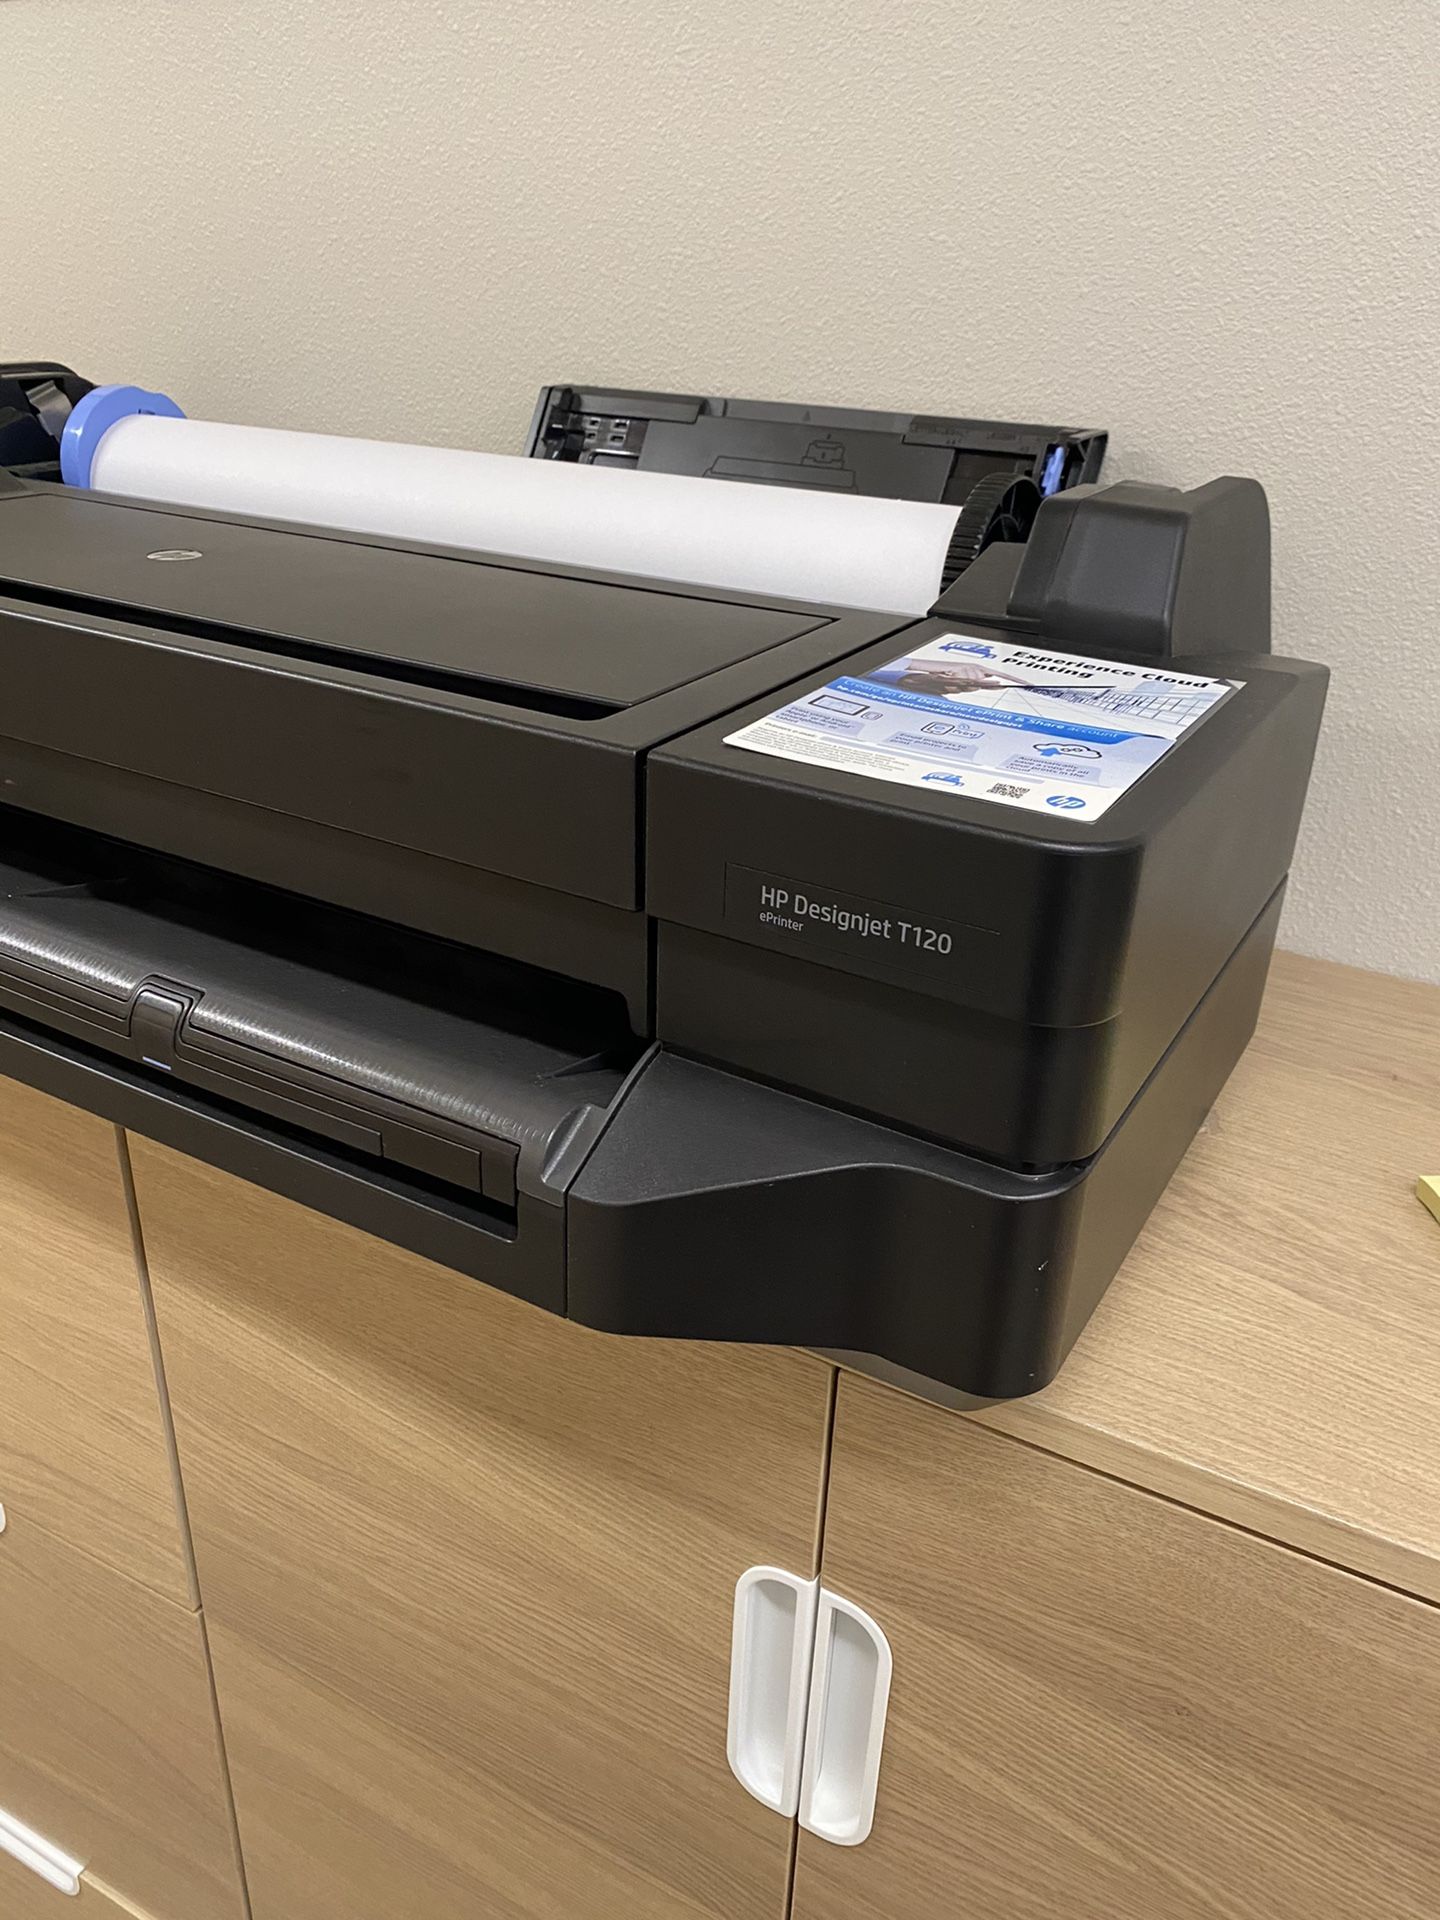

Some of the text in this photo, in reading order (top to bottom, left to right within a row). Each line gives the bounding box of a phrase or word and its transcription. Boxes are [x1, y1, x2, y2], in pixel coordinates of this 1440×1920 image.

[1002, 657, 1095, 679] Printing
[1013, 651, 1209, 688] Experience Cloud
[974, 709, 1014, 719] ePrint
[1026, 719, 1066, 728] Share
[1046, 796, 1086, 809] hp
[759, 911, 804, 932] ePrinter
[761, 885, 952, 955] HP Designjet T120
